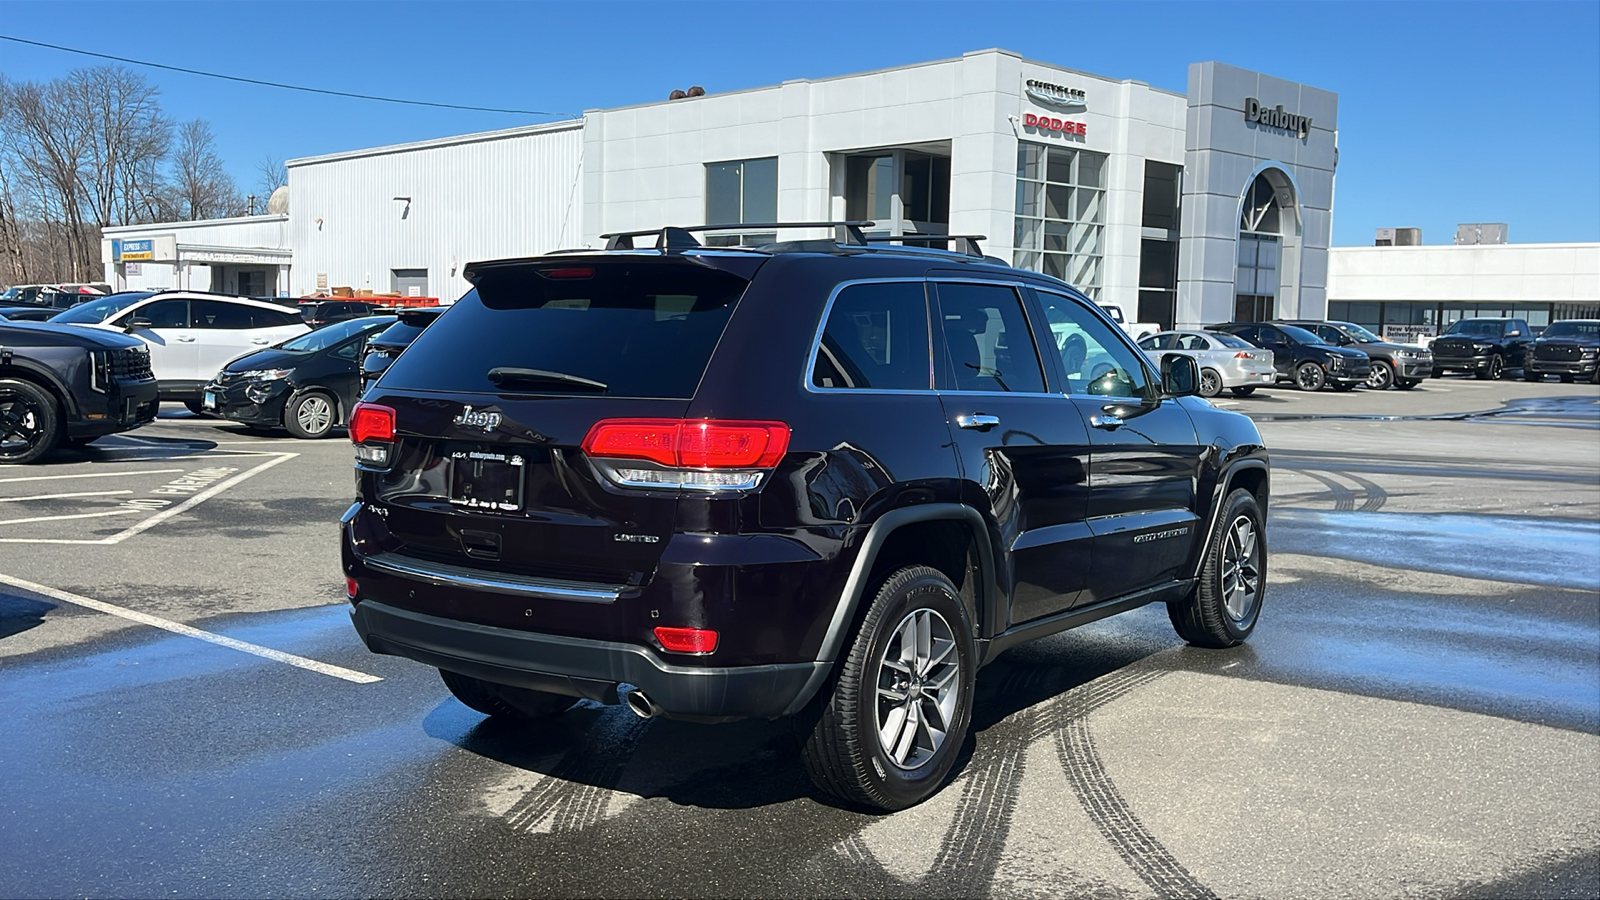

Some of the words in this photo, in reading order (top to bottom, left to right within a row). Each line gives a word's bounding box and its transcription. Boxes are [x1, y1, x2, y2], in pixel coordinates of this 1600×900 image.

[1026, 79, 1086, 97] CHRYSLER
[1024, 113, 1087, 136] DODGE
[1245, 97, 1313, 139] Danbury
[123, 242, 140, 251] EXPRESS
[453, 405, 503, 433] Jeep
[614, 533, 660, 543] LIMITED
